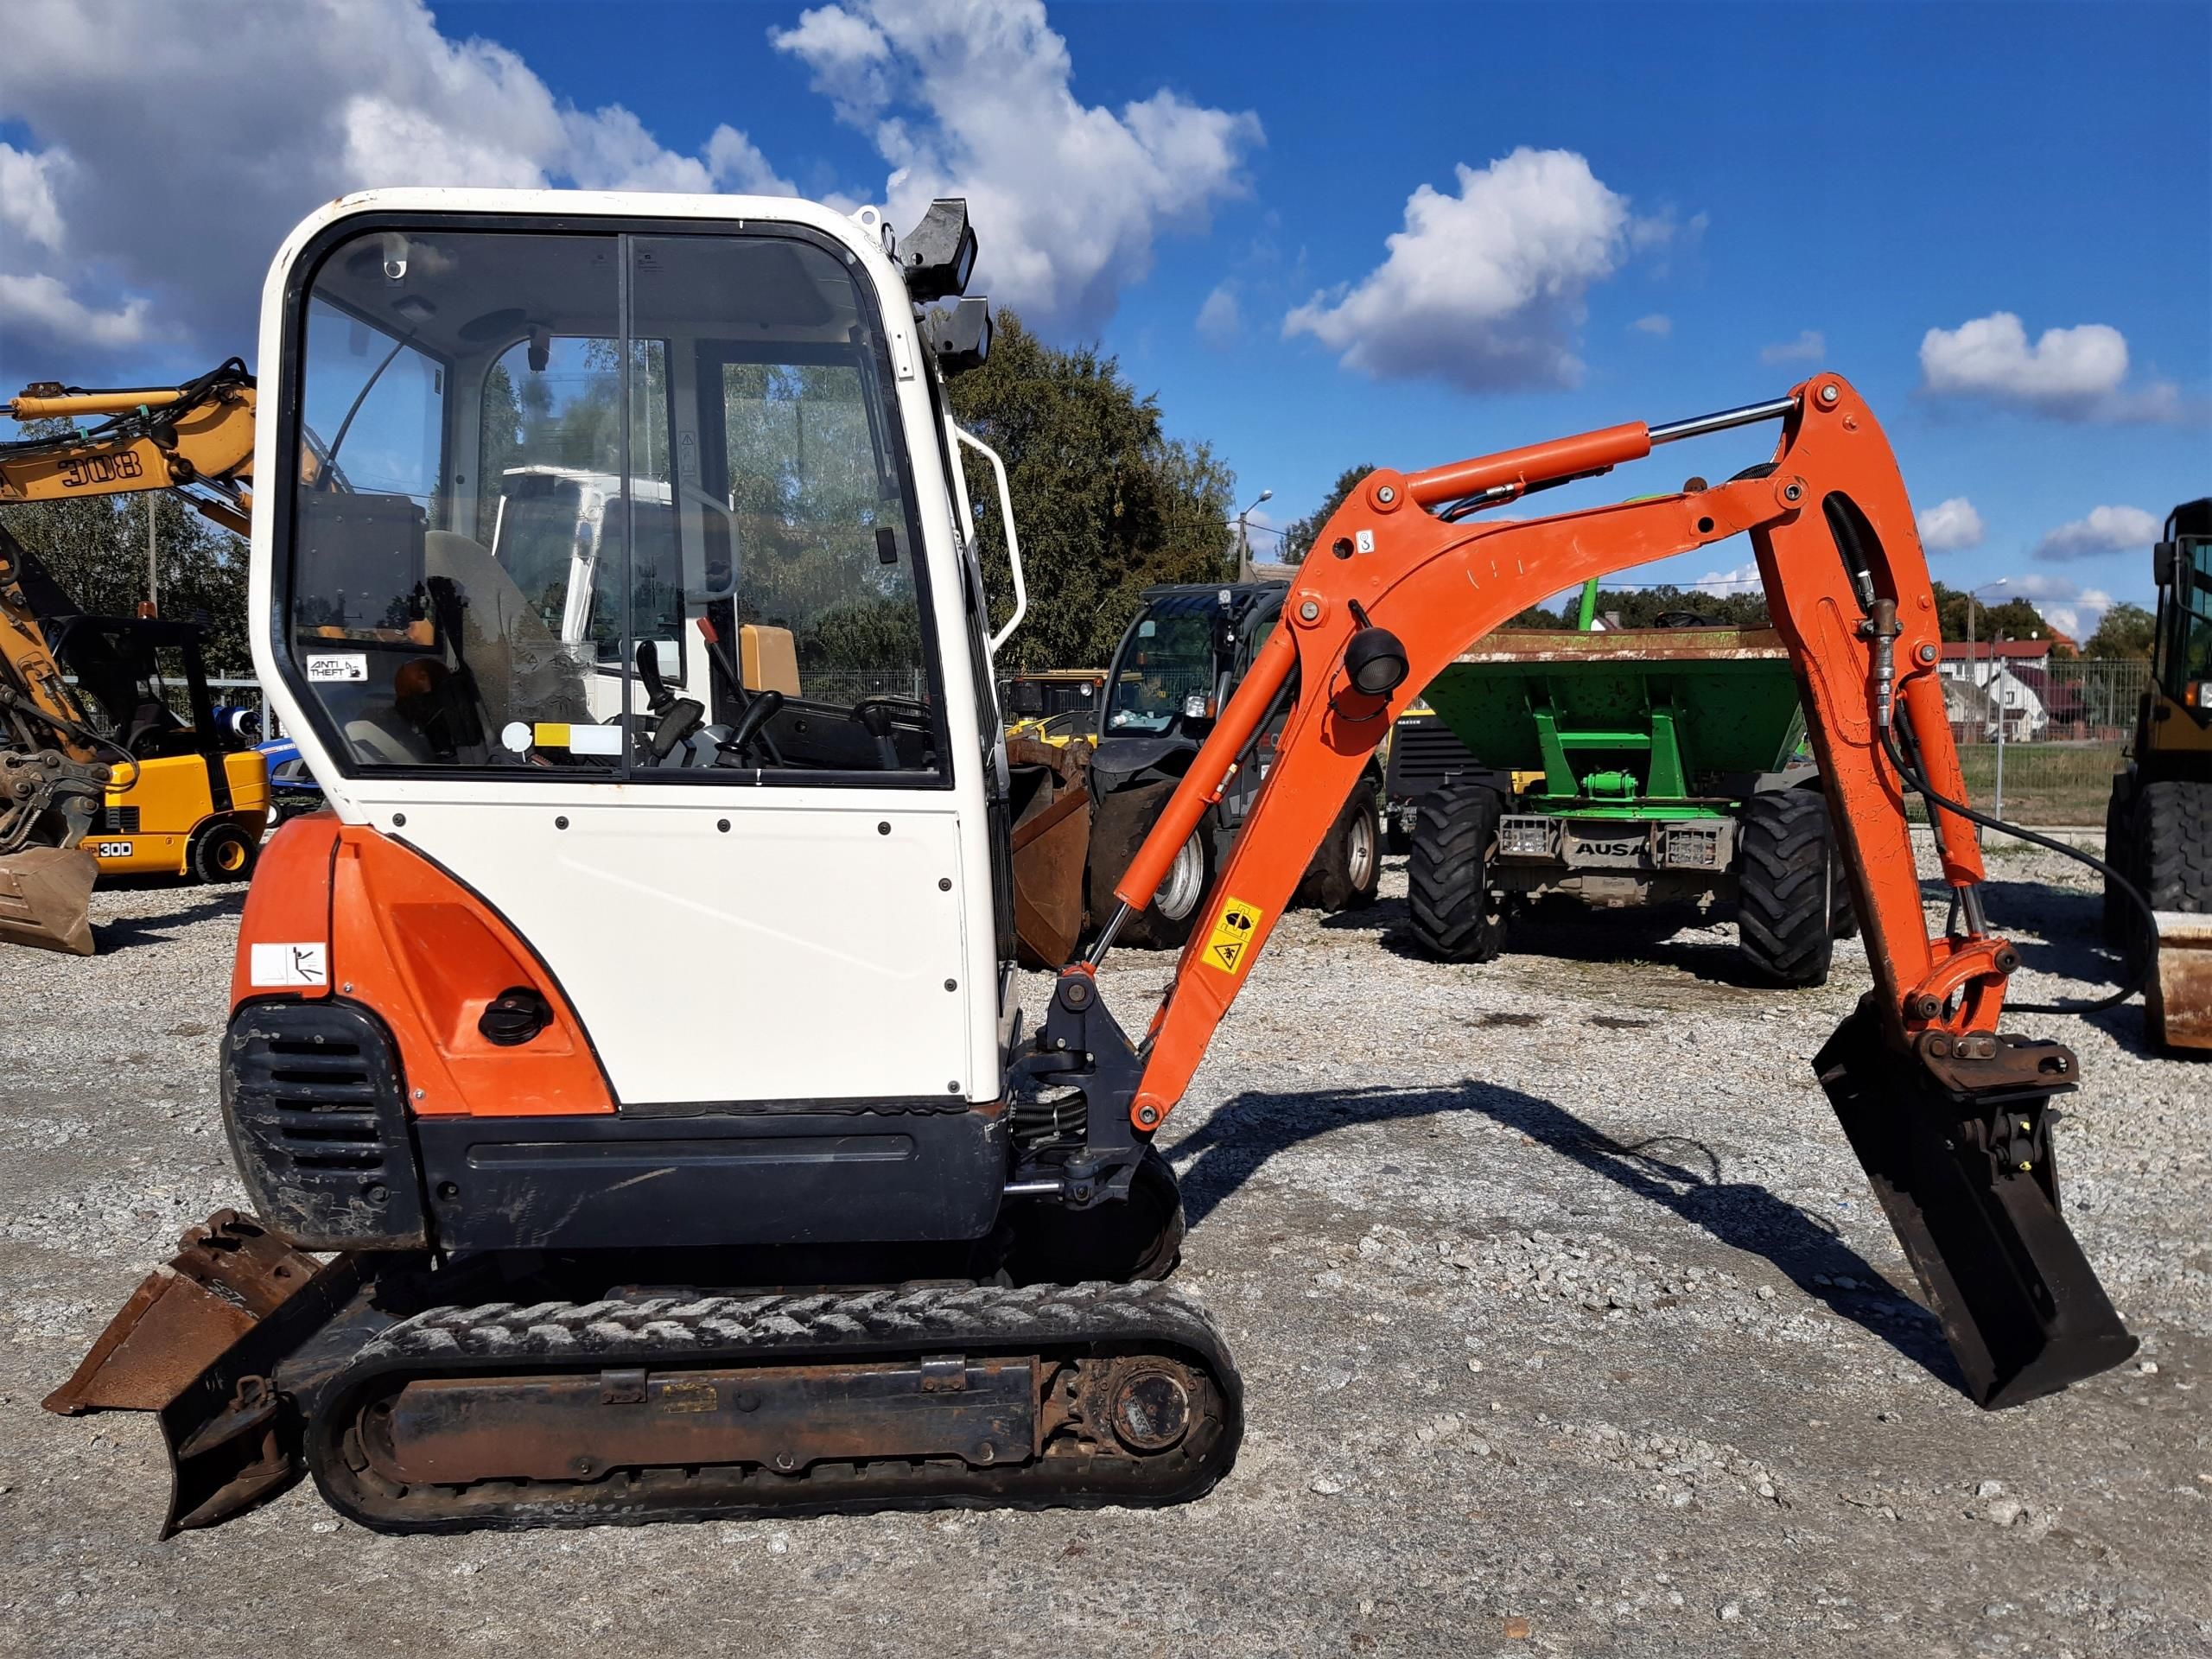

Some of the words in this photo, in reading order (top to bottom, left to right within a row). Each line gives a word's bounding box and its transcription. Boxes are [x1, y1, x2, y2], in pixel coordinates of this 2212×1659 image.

[58, 451, 143, 487] 308
[100, 842, 131, 856] 30D
[1575, 843, 1649, 856] AUSA
